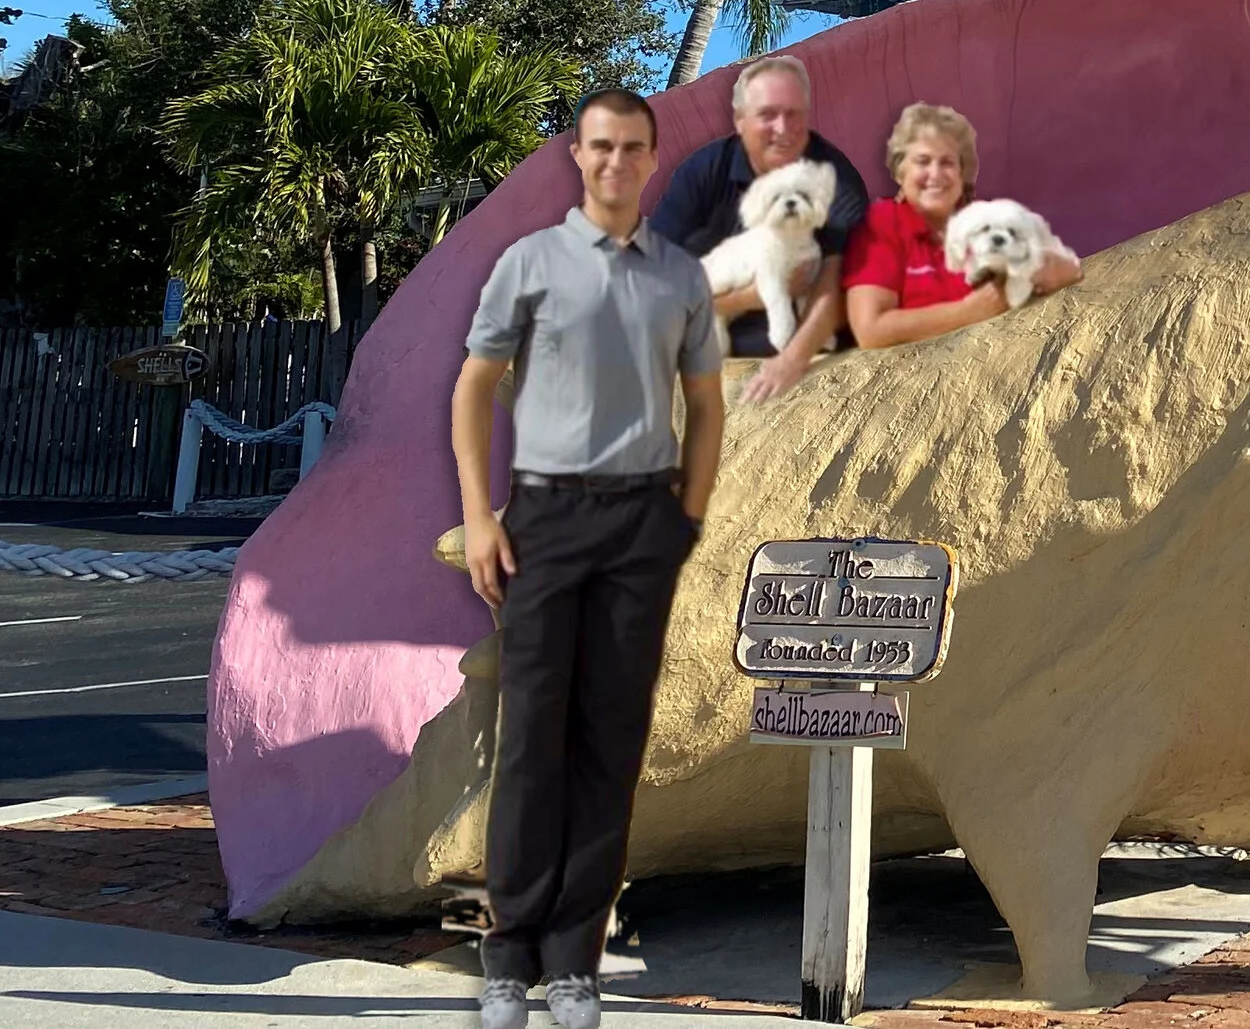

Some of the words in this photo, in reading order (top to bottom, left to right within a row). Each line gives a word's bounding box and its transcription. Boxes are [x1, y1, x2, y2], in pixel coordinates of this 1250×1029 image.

[137, 357, 183, 373] SHELLS
[828, 550, 874, 580] The
[755, 582, 824, 617] Shell
[835, 584, 935, 620] Bazaar
[759, 637, 858, 662] Founded
[864, 639, 914, 665] 1953
[754, 696, 902, 738] shellbazaar.com
